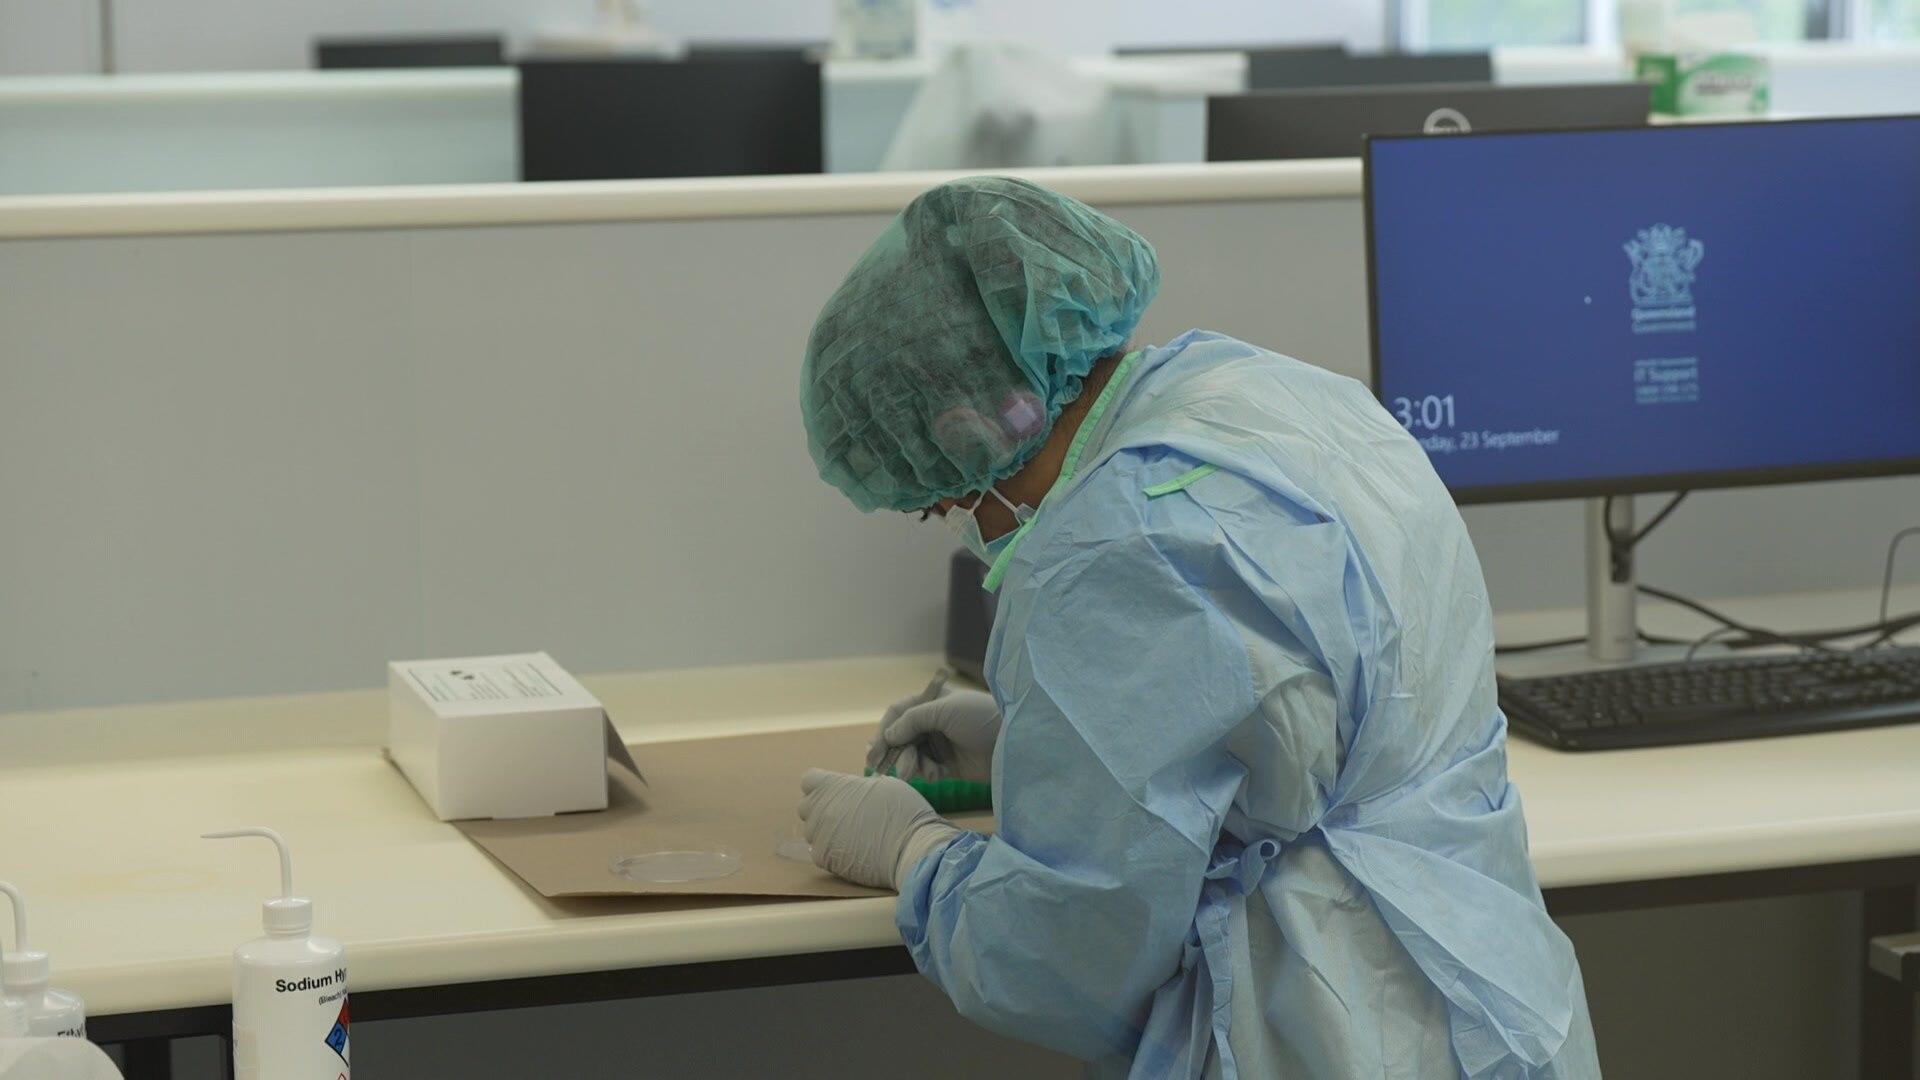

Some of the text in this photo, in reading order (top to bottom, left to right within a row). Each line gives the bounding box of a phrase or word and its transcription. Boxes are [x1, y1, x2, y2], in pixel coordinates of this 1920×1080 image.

[1393, 394, 1455, 431] 3:01
[1459, 431, 1480, 450] 23
[1481, 428, 1560, 451] September
[275, 975, 333, 993] Sodium
[334, 1028, 343, 1047] 2
